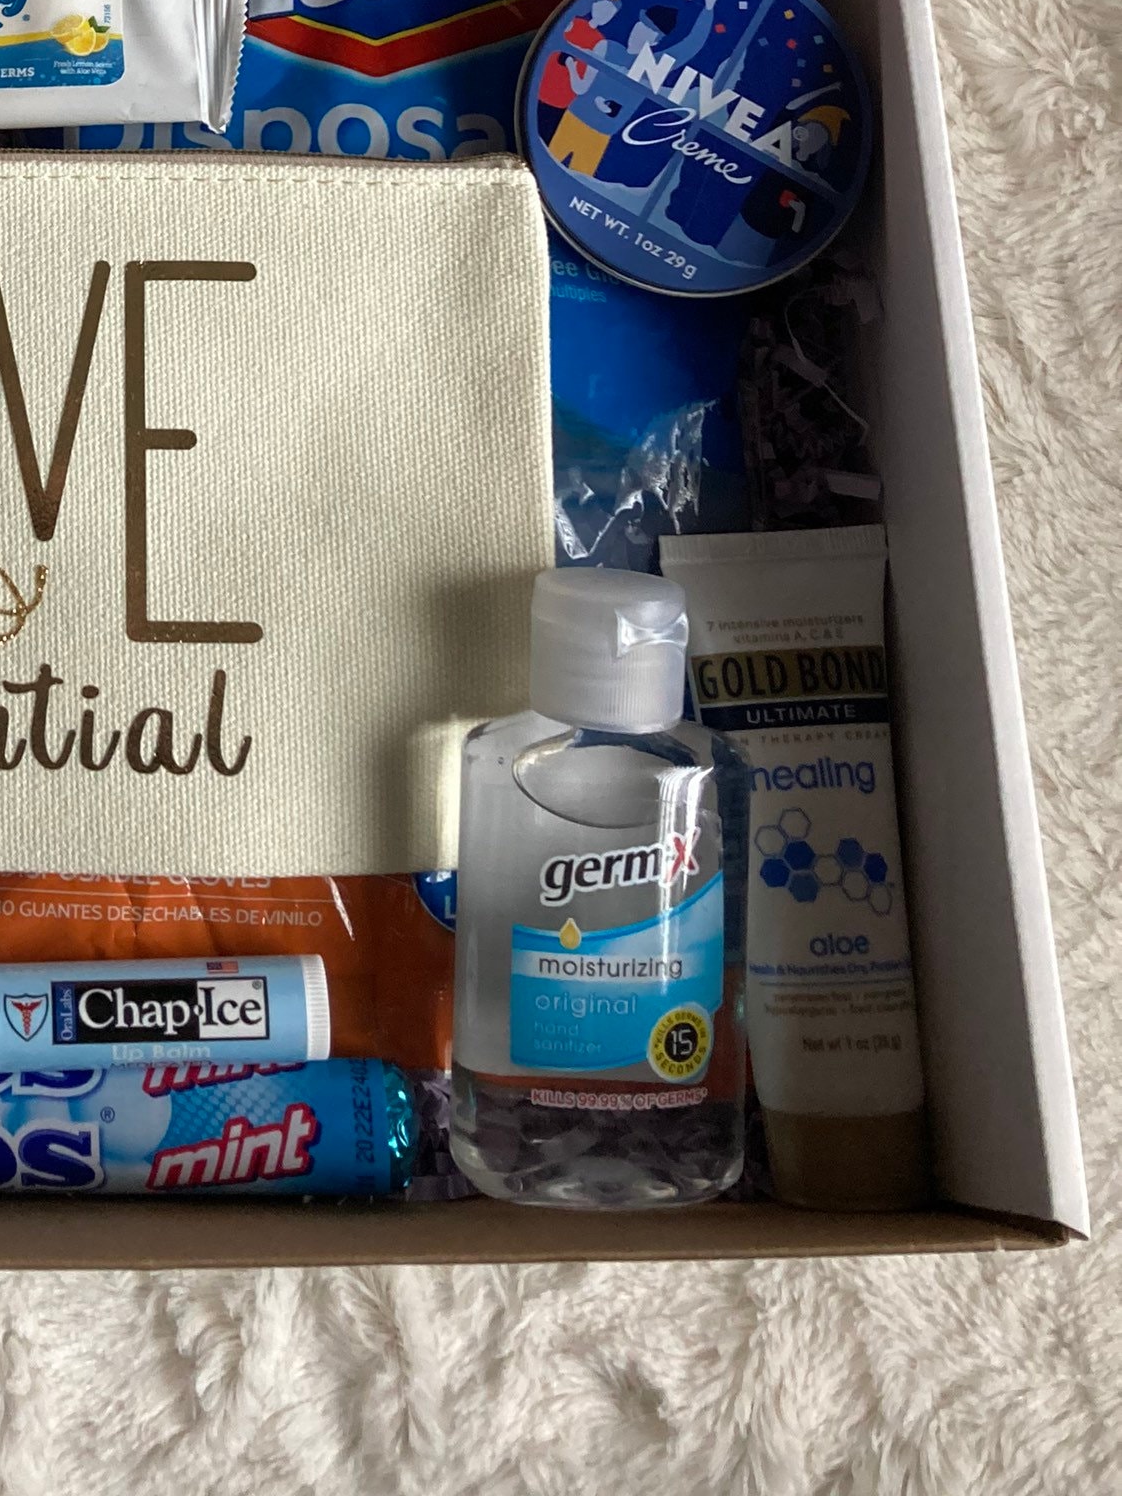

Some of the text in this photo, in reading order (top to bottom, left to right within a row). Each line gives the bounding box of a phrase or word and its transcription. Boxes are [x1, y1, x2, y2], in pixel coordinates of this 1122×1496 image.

[627, 42, 793, 168] NIVEA
[621, 106, 753, 186] Creme
[569, 195, 602, 221] NET
[604, 213, 629, 240] WT.
[697, 650, 887, 700] GOLD BOND
[745, 703, 857, 725] ULTIMATE
[19, 901, 103, 921] GUANTES
[107, 905, 231, 924] DESECHABLES
[236, 909, 259, 925] DE
[265, 910, 323, 927] VINILO
[809, 934, 871, 957] aloe
[538, 954, 684, 979] moisturizing
[534, 992, 638, 1019] original
[534, 1020, 579, 1036] hand
[112, 1044, 212, 1062] Lip Balm
[533, 1038, 603, 1054] sanitizer
[670, 1028, 694, 1056] 15
[531, 1089, 576, 1108] KILLS
[150, 1105, 315, 1188] mint
